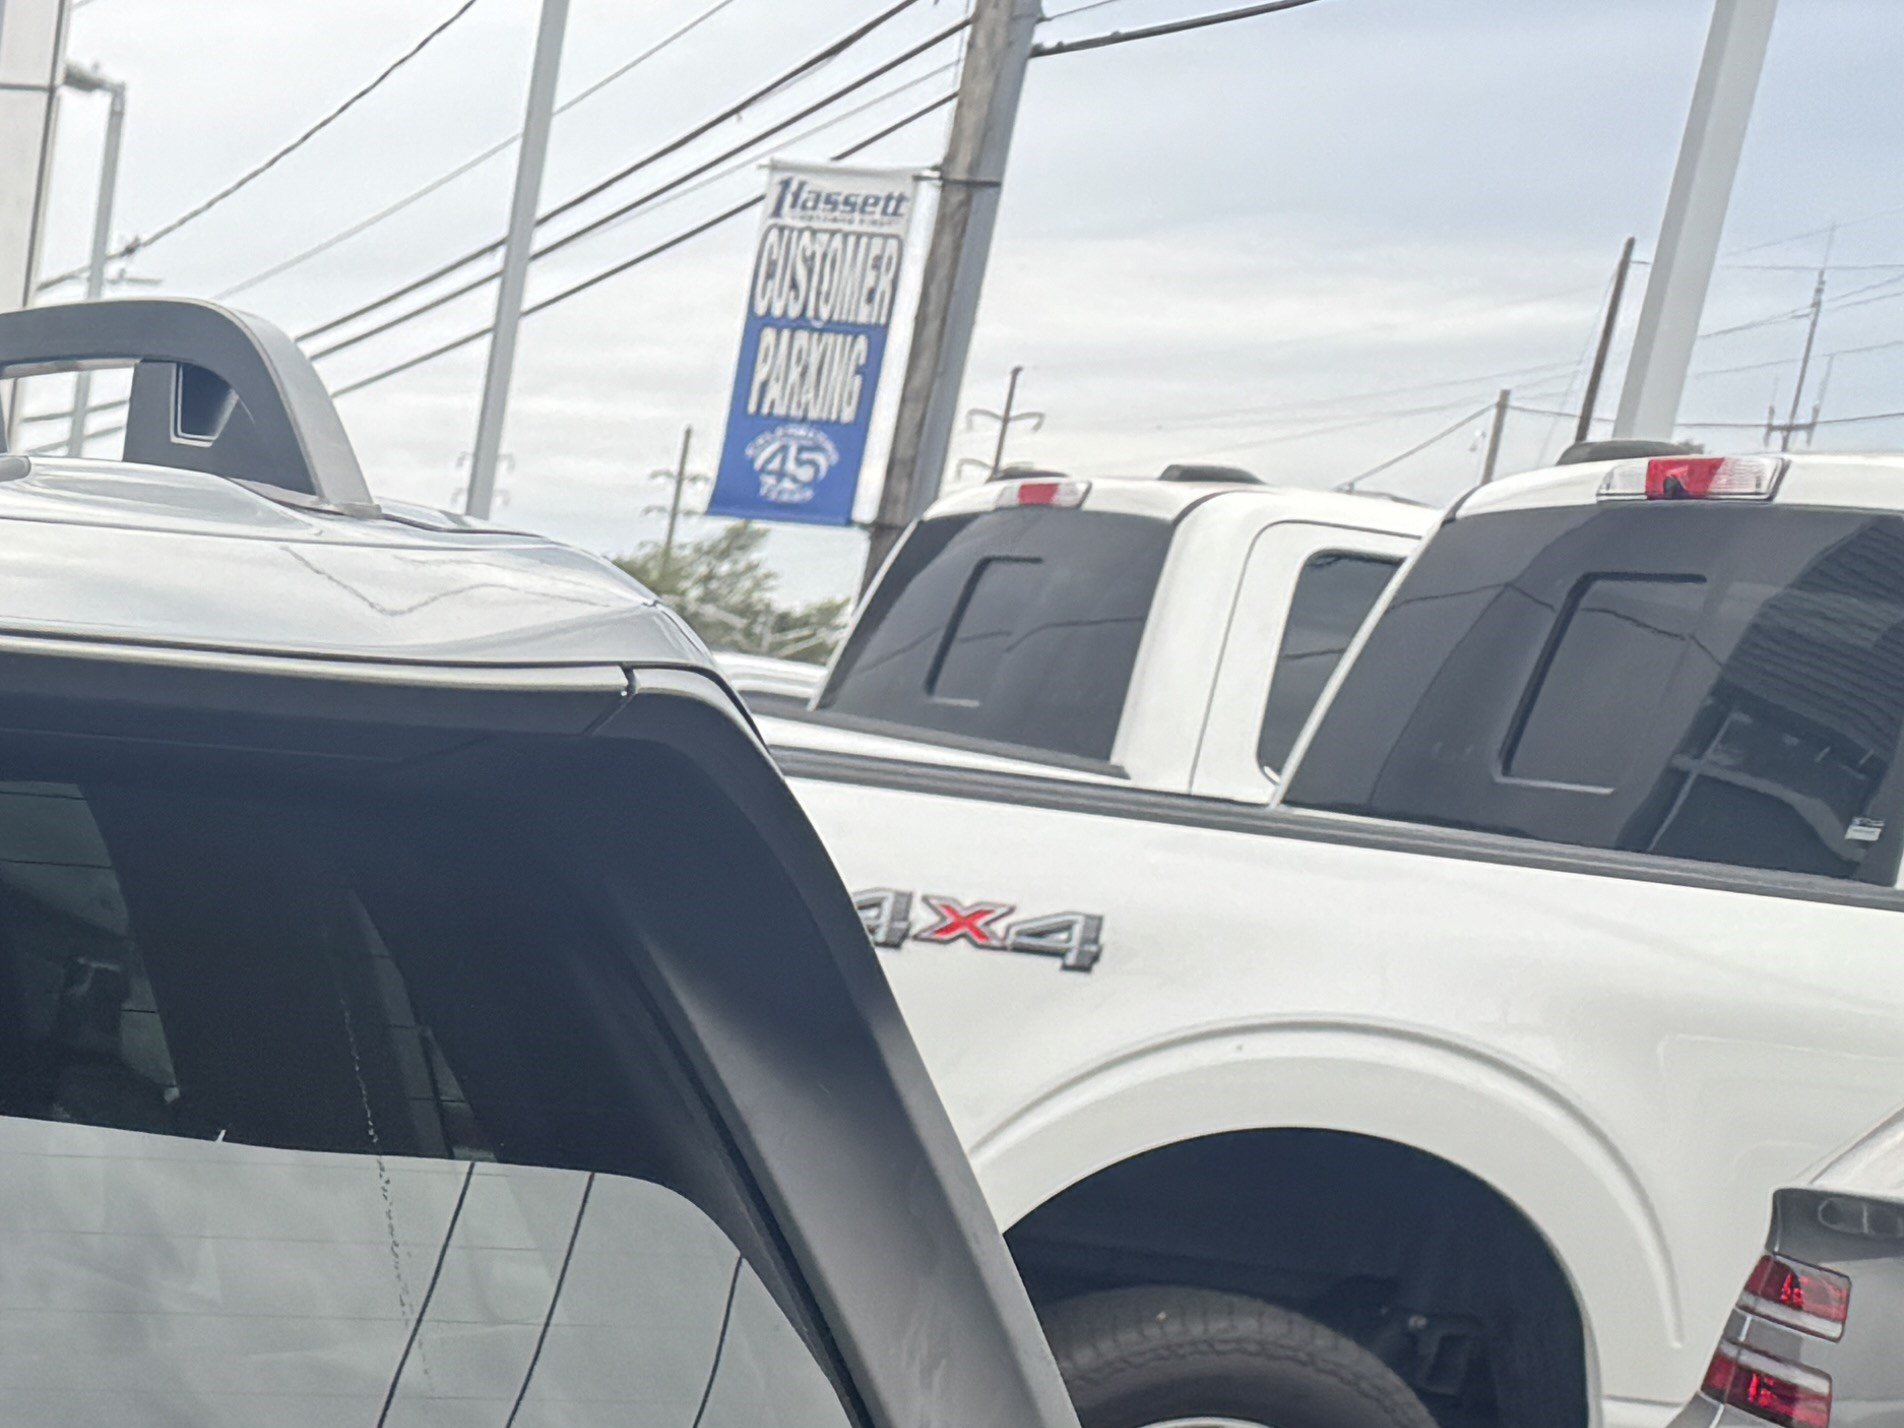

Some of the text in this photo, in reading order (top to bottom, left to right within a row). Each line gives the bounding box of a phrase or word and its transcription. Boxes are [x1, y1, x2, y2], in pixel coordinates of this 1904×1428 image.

[769, 176, 910, 218] Hassett
[754, 227, 902, 325] CUSTOMER
[747, 328, 869, 424] PARKING
[755, 440, 826, 486] 45
